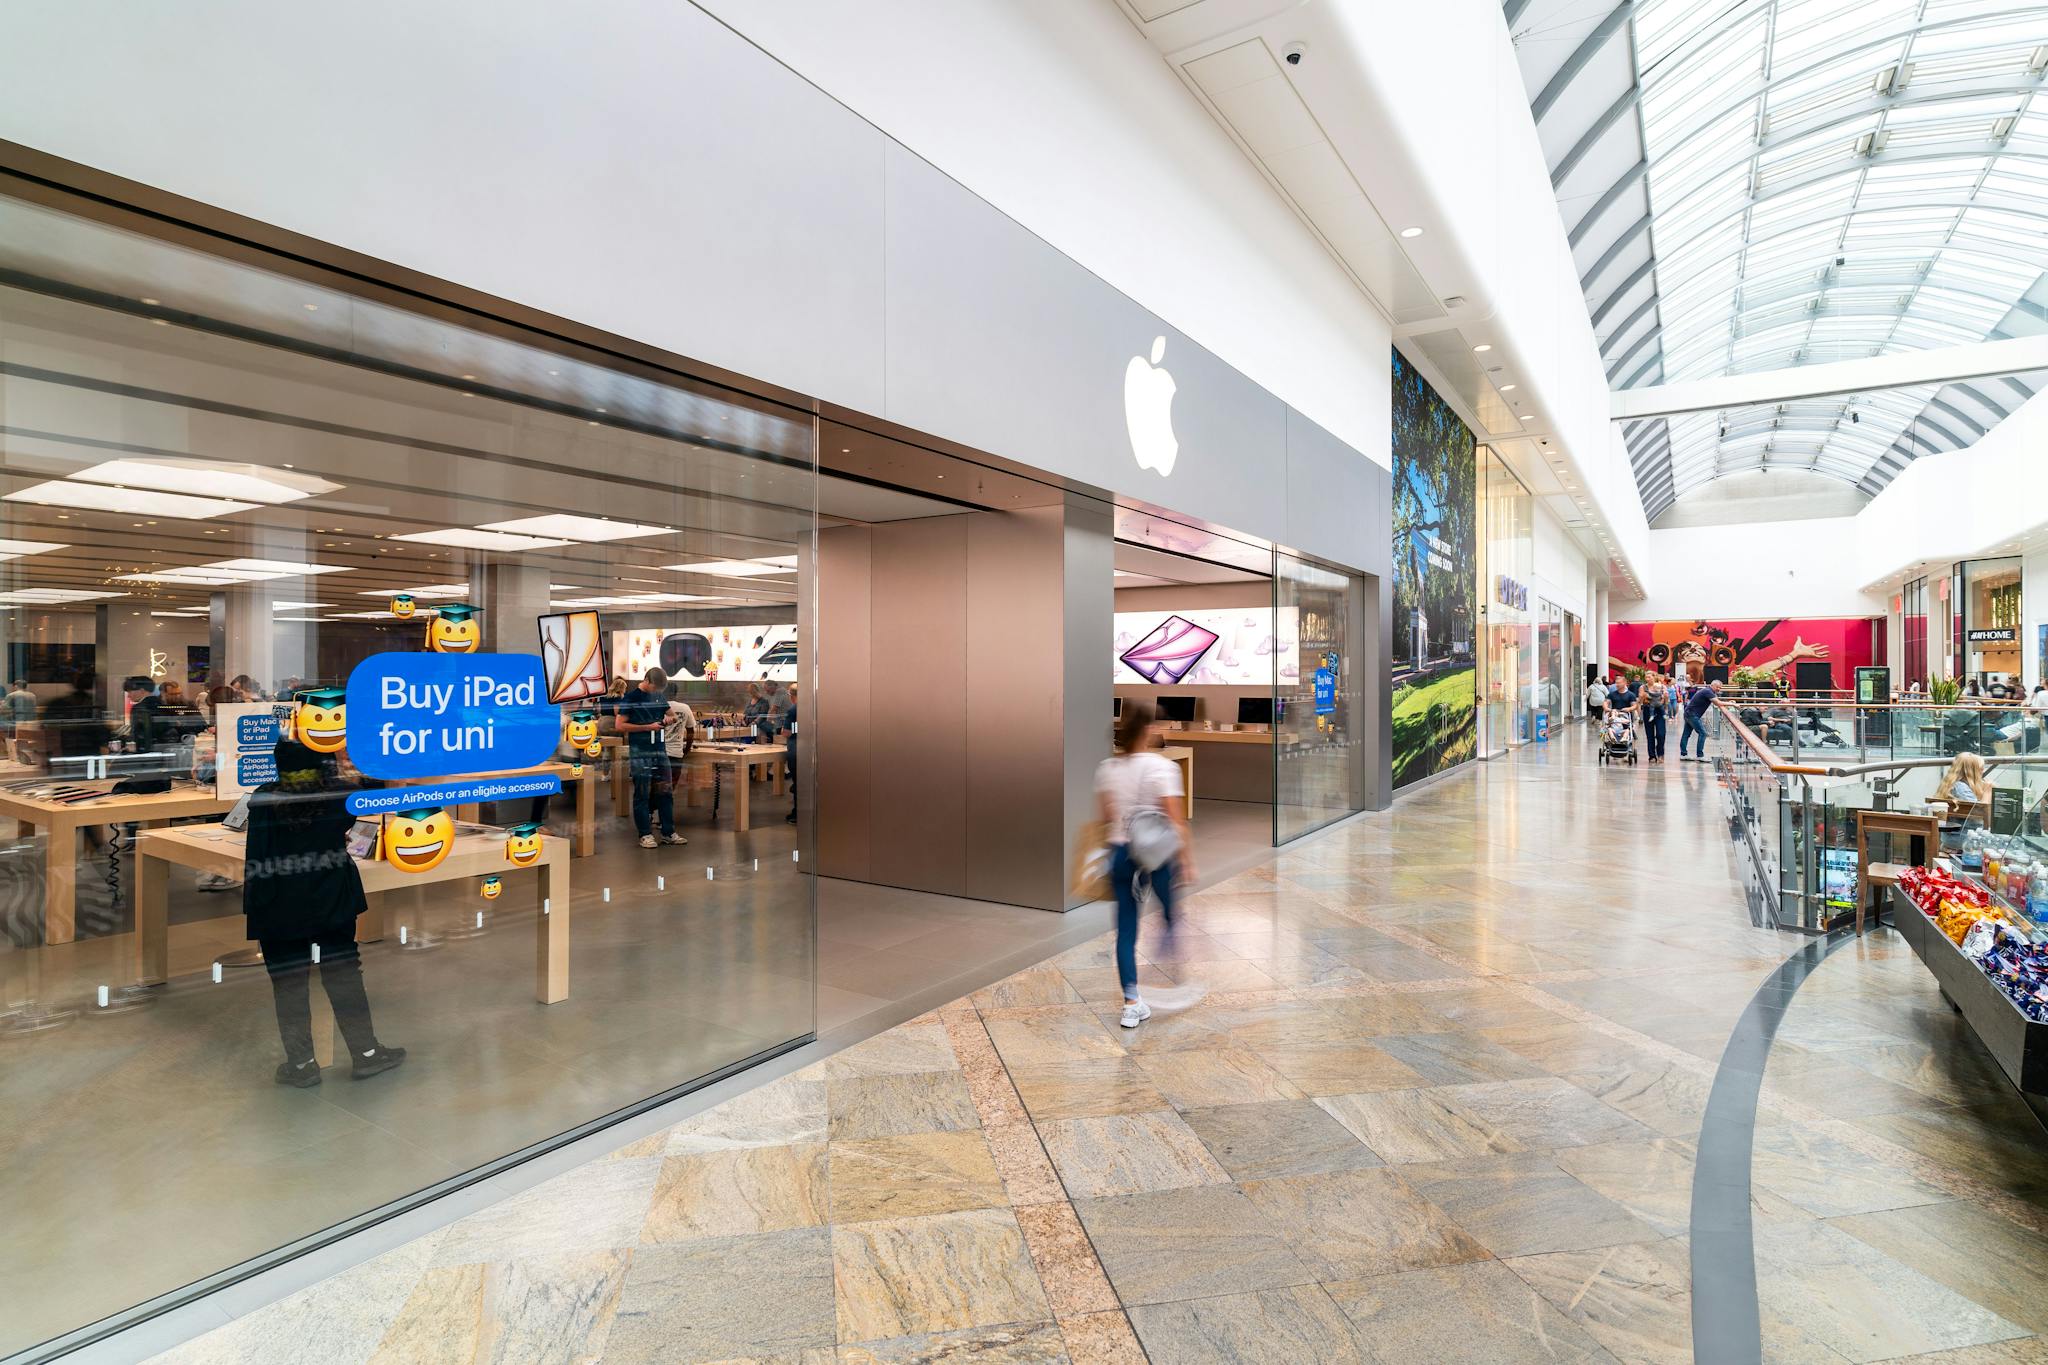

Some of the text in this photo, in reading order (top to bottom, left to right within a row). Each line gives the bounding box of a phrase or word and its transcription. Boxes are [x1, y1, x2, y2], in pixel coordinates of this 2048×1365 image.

[1983, 631, 2011, 639] HOME
[381, 675, 535, 715] Buy iPad
[260, 718, 277, 726] Mac
[255, 733, 268, 741] uni
[379, 718, 494, 756] for uni
[252, 769, 276, 777] eligible
[243, 776, 278, 784] accessory
[355, 780, 555, 809] Choose AirPods or an eligible accessory
